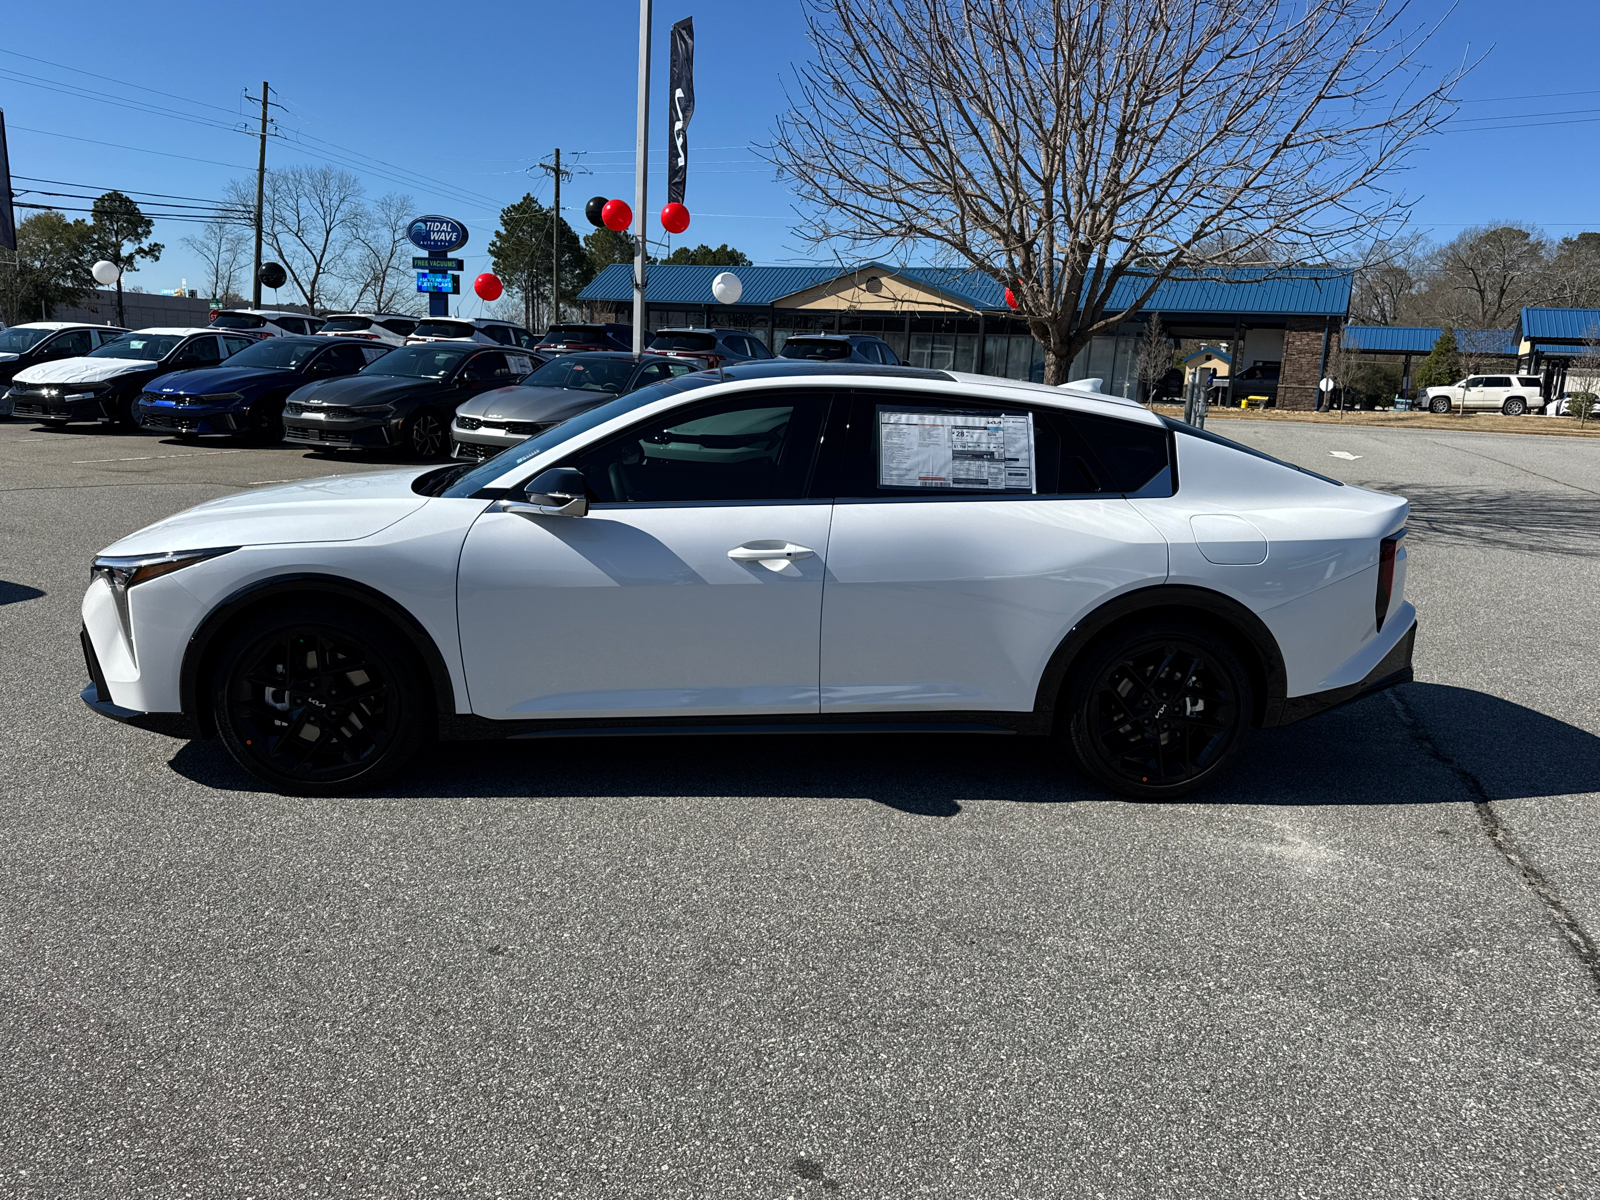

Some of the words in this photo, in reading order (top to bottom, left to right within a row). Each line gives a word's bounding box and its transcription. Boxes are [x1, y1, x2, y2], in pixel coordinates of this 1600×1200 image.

[426, 222, 452, 231] TIDAL
[430, 232, 457, 241] WAVE
[955, 430, 965, 438] 28
[308, 697, 326, 709] KIA
[1154, 703, 1168, 719] KIA
